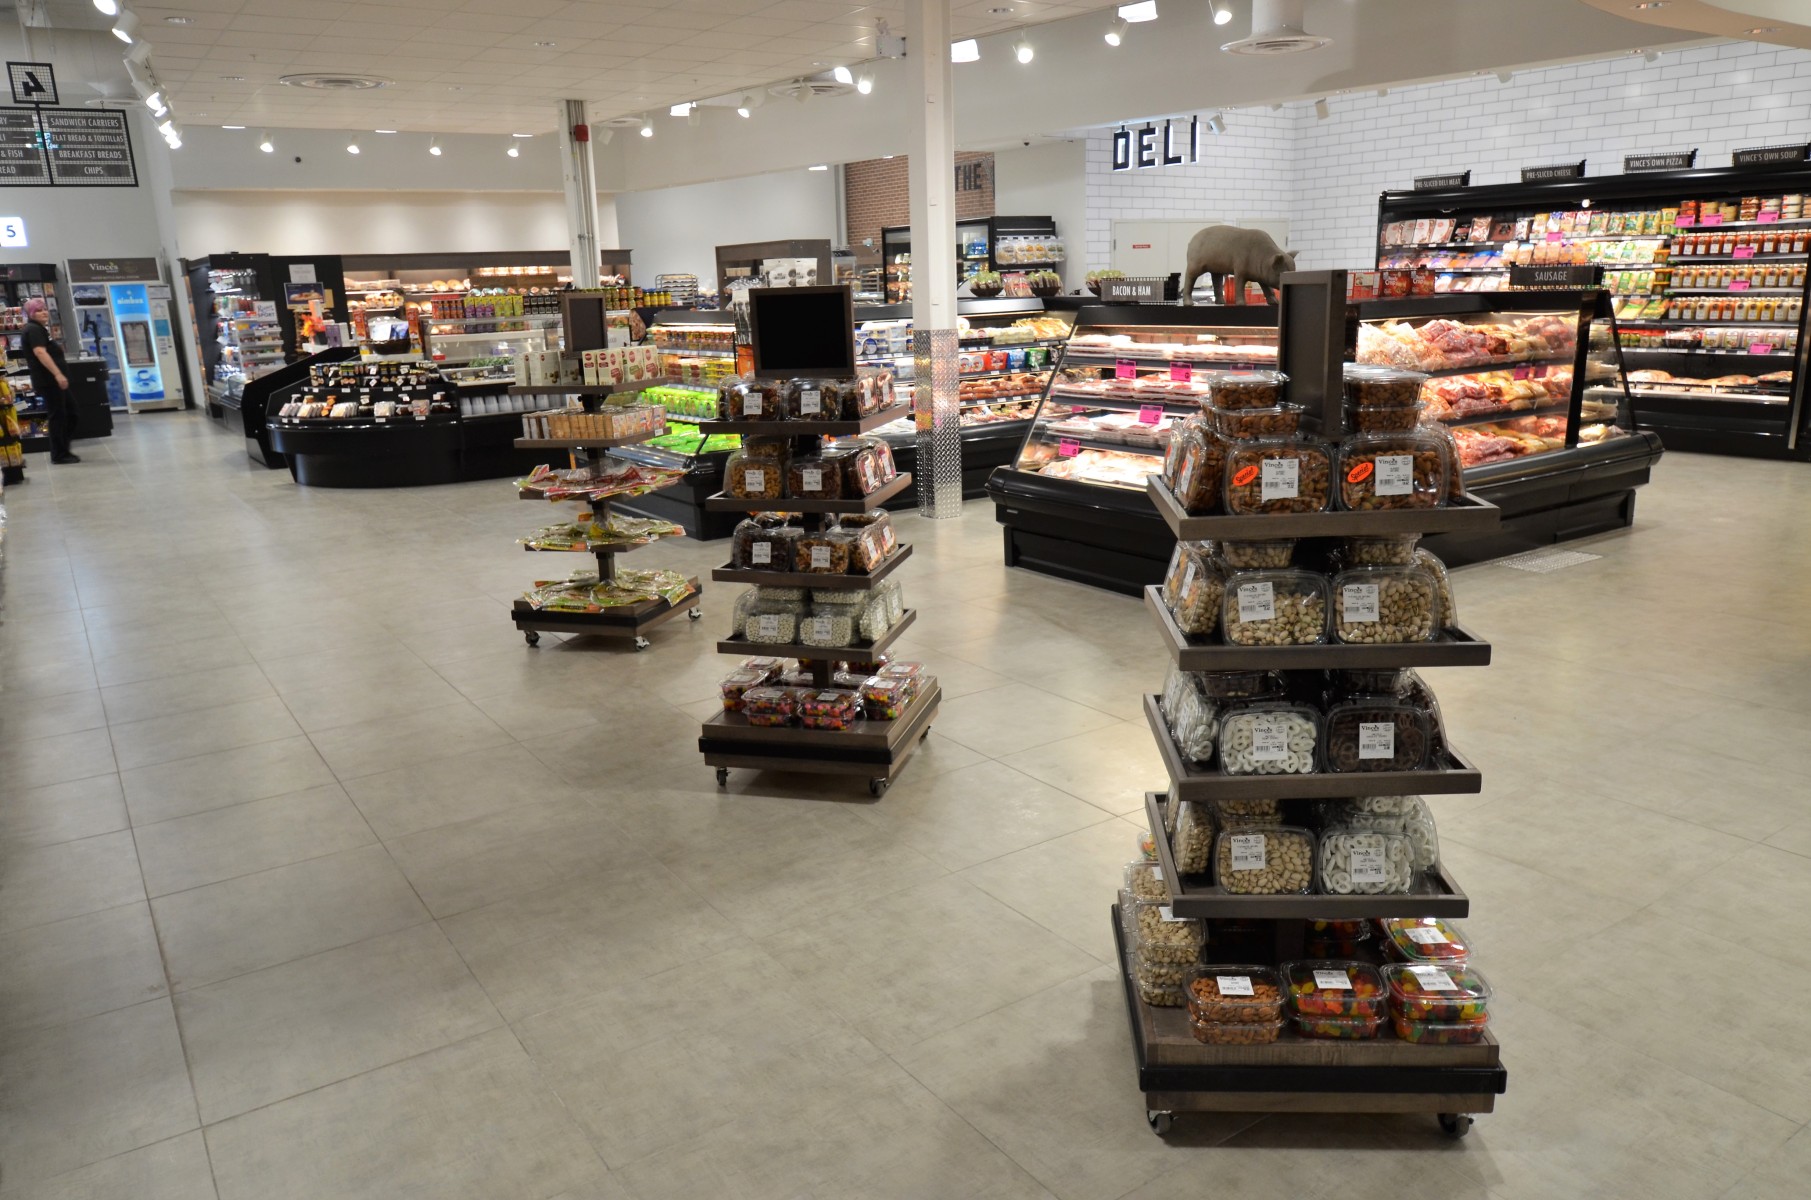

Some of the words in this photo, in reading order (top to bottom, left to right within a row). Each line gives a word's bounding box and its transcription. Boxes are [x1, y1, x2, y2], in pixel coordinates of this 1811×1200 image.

[50, 118, 87, 127] SANDWICH
[88, 119, 119, 128] CARRIERS
[93, 135, 124, 143] TORTILLAS
[1112, 122, 1200, 171] DELI
[7, 149, 24, 158] FISH
[59, 151, 97, 159] BREAKFAST
[97, 151, 122, 159] BREADS
[1739, 153, 1763, 162] VINCE'S
[1764, 152, 1779, 161] OWN
[1780, 151, 1798, 160] SOUP
[1629, 160, 1650, 168] VINCE'S
[1651, 159, 1665, 167] OWN
[1666, 158, 1683, 166] PIZZA
[84, 166, 104, 174] CHIPS
[1526, 170, 1553, 179] PRE-SLICED
[1554, 168, 1572, 177] CHEESE
[1415, 180, 1438, 188] PRE-SLICED
[1439, 179, 1448, 187] DELI
[1449, 178, 1461, 186] MEAT
[6, 225, 17, 238] 5
[1534, 271, 1567, 281] SAUSAGE
[1112, 285, 1130, 296] BACON
[1131, 286, 1137, 296] &
[1137, 285, 1151, 296] HAM
